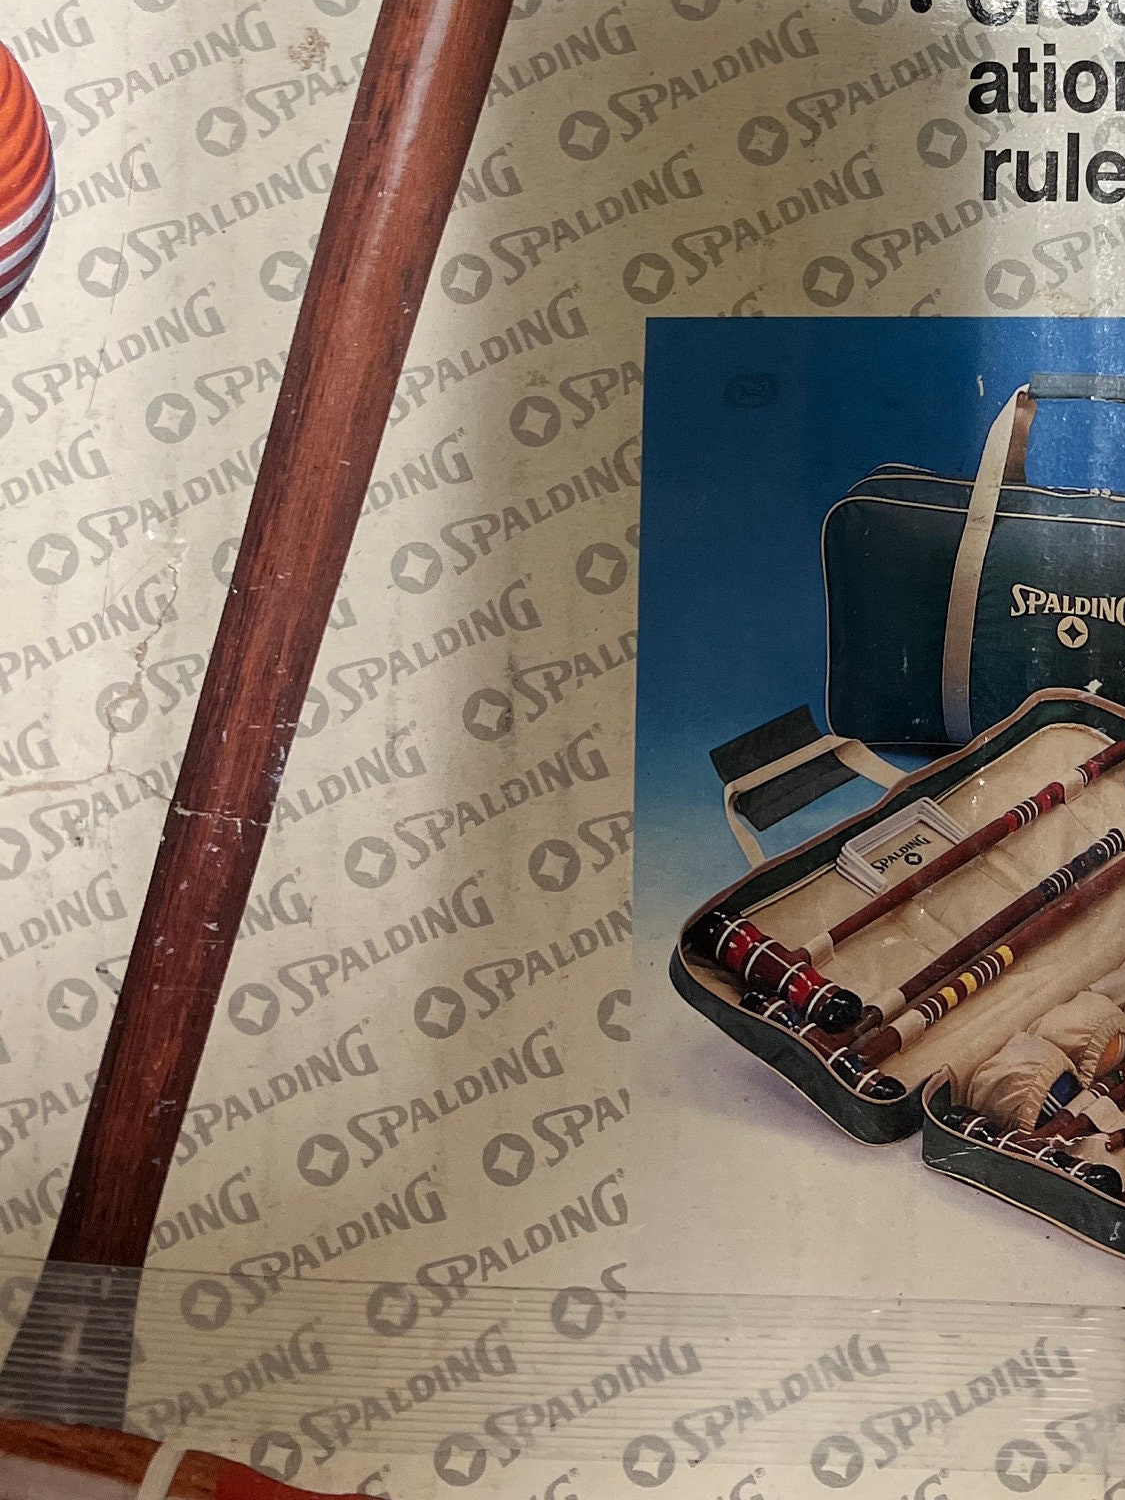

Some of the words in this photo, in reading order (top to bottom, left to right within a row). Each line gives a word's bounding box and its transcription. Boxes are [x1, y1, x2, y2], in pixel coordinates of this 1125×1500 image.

[64, 2, 272, 136] SPALDING
[609, 8, 816, 142] SPALDING
[787, 13, 993, 147] SPALDING
[127, 144, 335, 279] SPALDING
[492, 150, 699, 285] SPALDING
[673, 150, 881, 285] SPALDING
[12, 287, 222, 423] SPALDING
[442, 437, 651, 574] SPALDING
[327, 580, 538, 718] SPALDING
[395, 730, 606, 869] SPALDING
[870, 834, 931, 875] SPALDING
[278, 876, 490, 1016] SPALDING
[348, 1026, 560, 1167] SPALDING
[230, 1171, 443, 1314] SPALDING
[417, 1174, 627, 1316] SPALDING
[300, 1322, 514, 1466] SPALDING
[485, 1323, 699, 1467] SPALDING
[674, 1324, 887, 1467] SPALDING
[861, 1326, 1074, 1469] SPALDING
